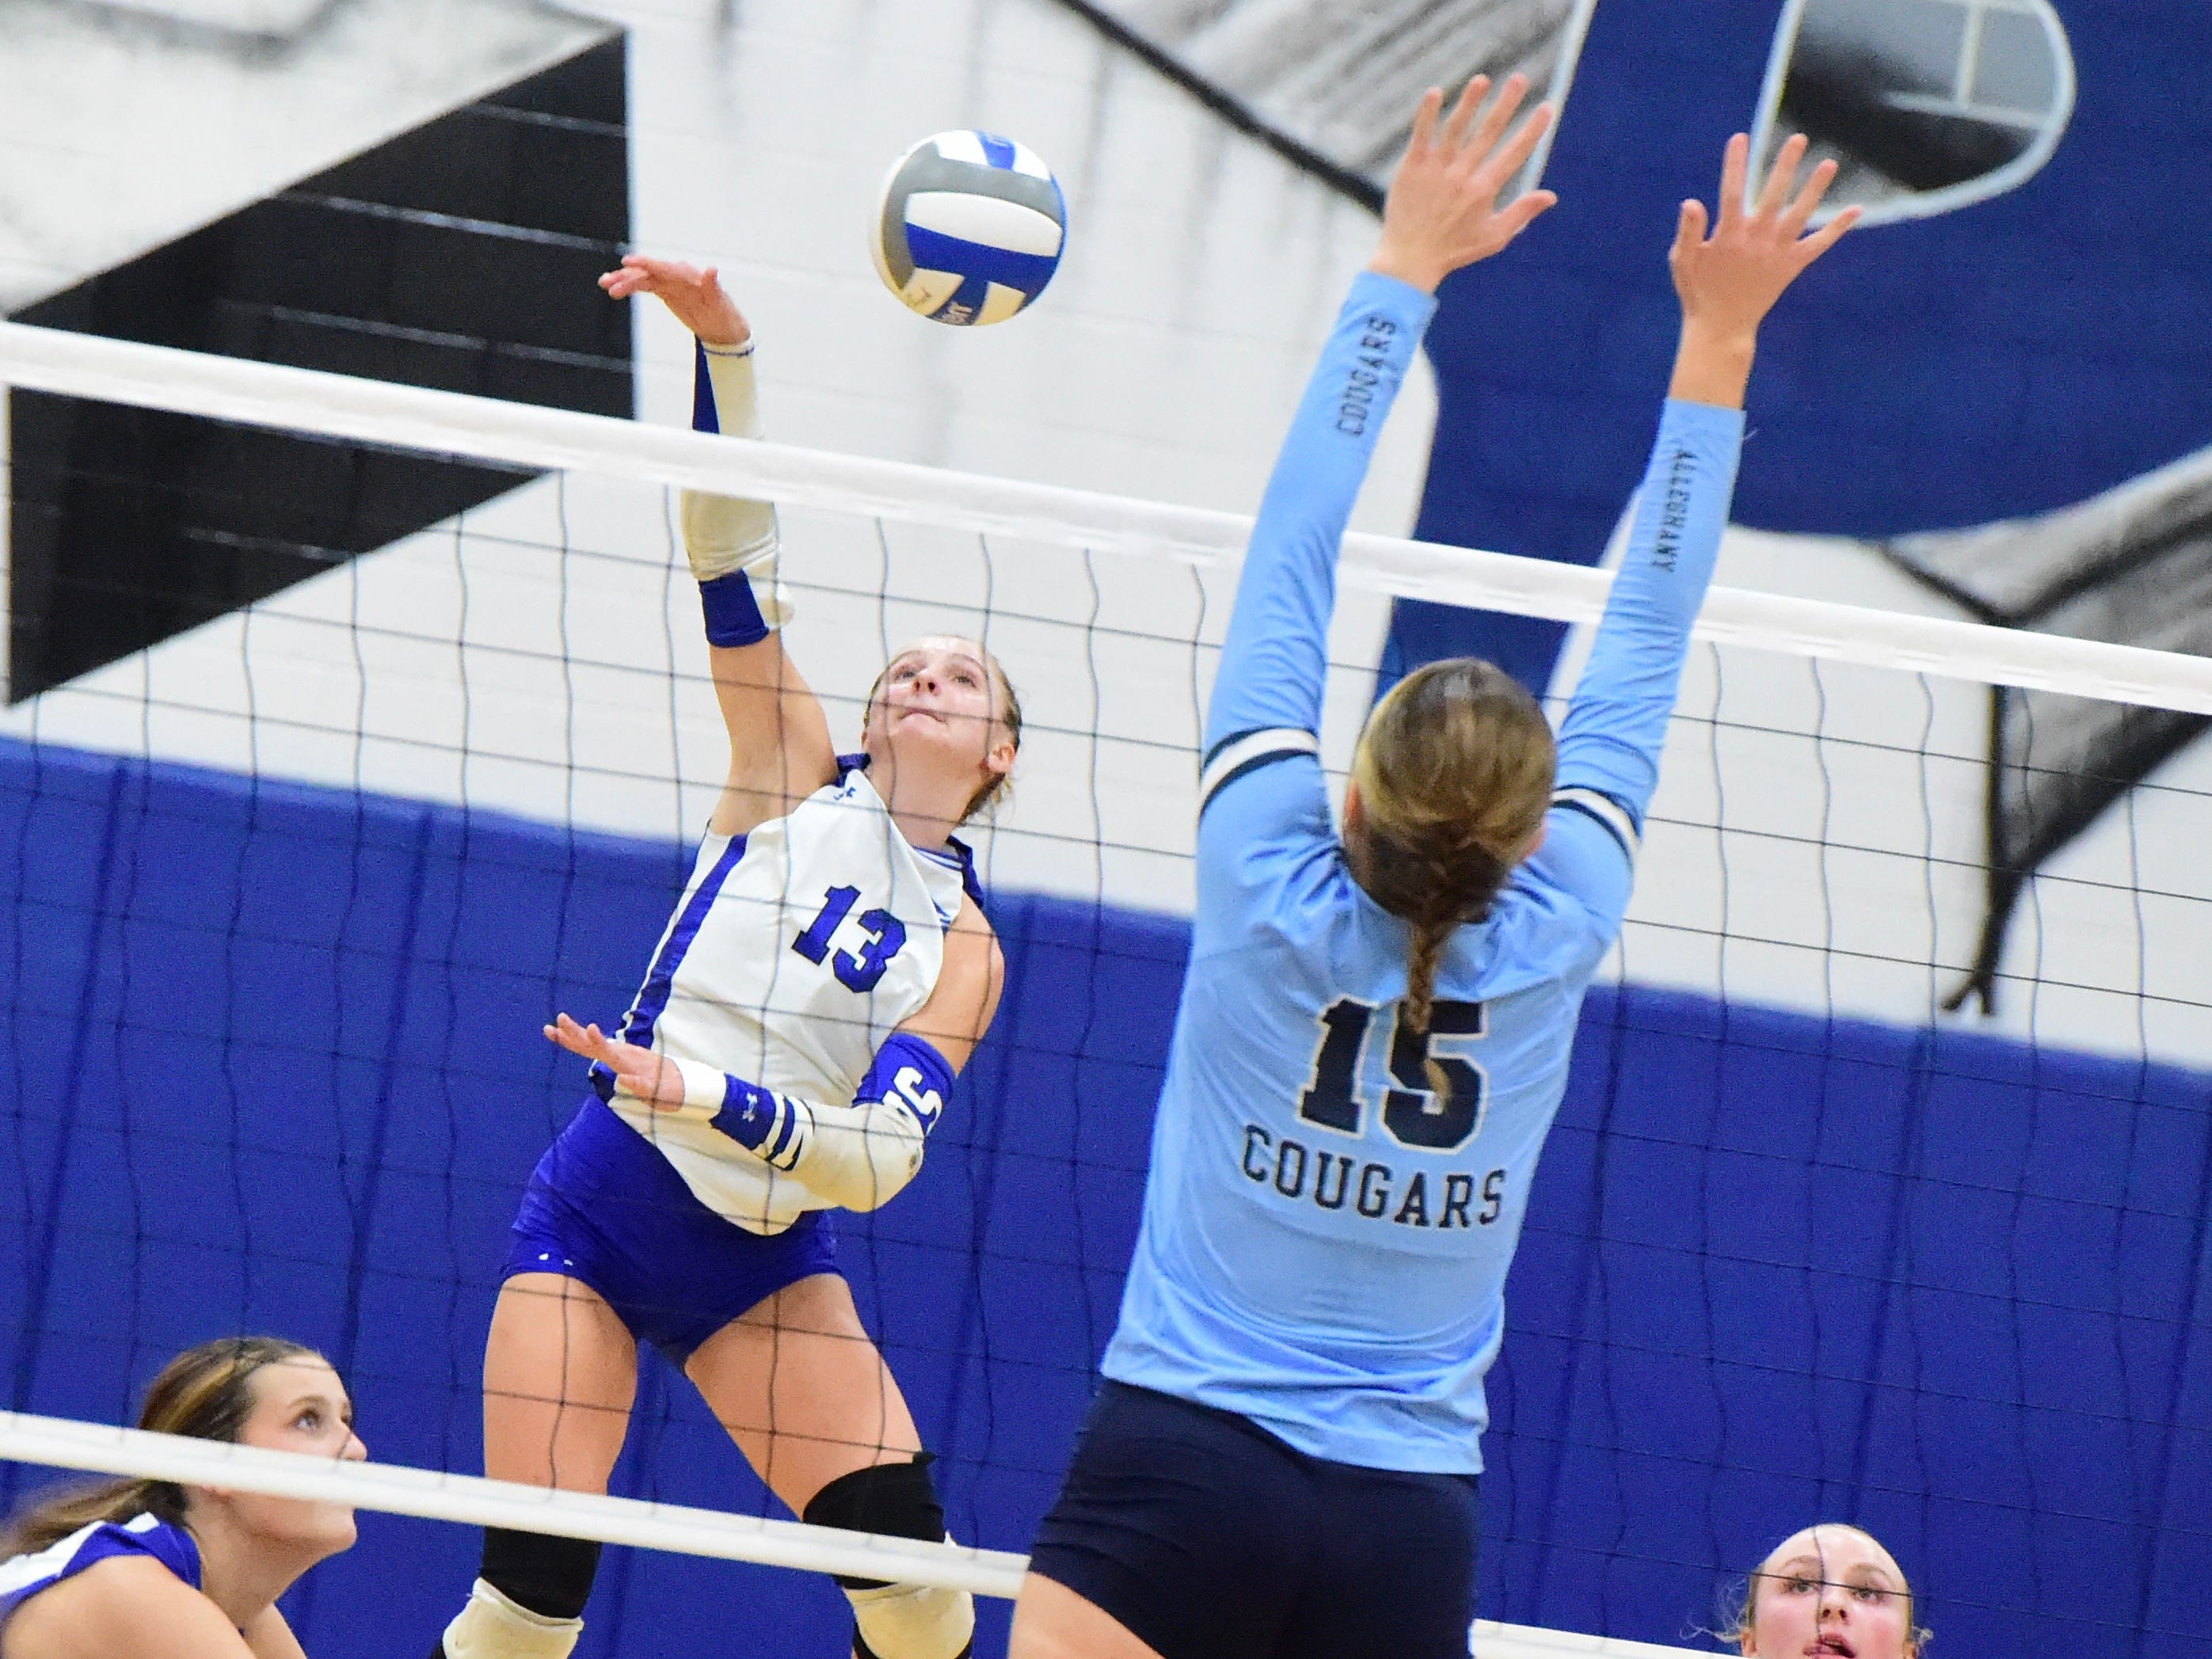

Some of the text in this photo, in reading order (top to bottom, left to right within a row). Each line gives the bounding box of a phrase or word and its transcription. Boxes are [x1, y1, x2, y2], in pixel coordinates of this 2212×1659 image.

[1335, 314, 1397, 436] COUGARS
[1650, 449, 1698, 573] ALLEGHANY
[790, 884, 907, 993] 13
[1296, 993, 1489, 1155] 15
[1243, 1124, 1506, 1228] COUGARS
